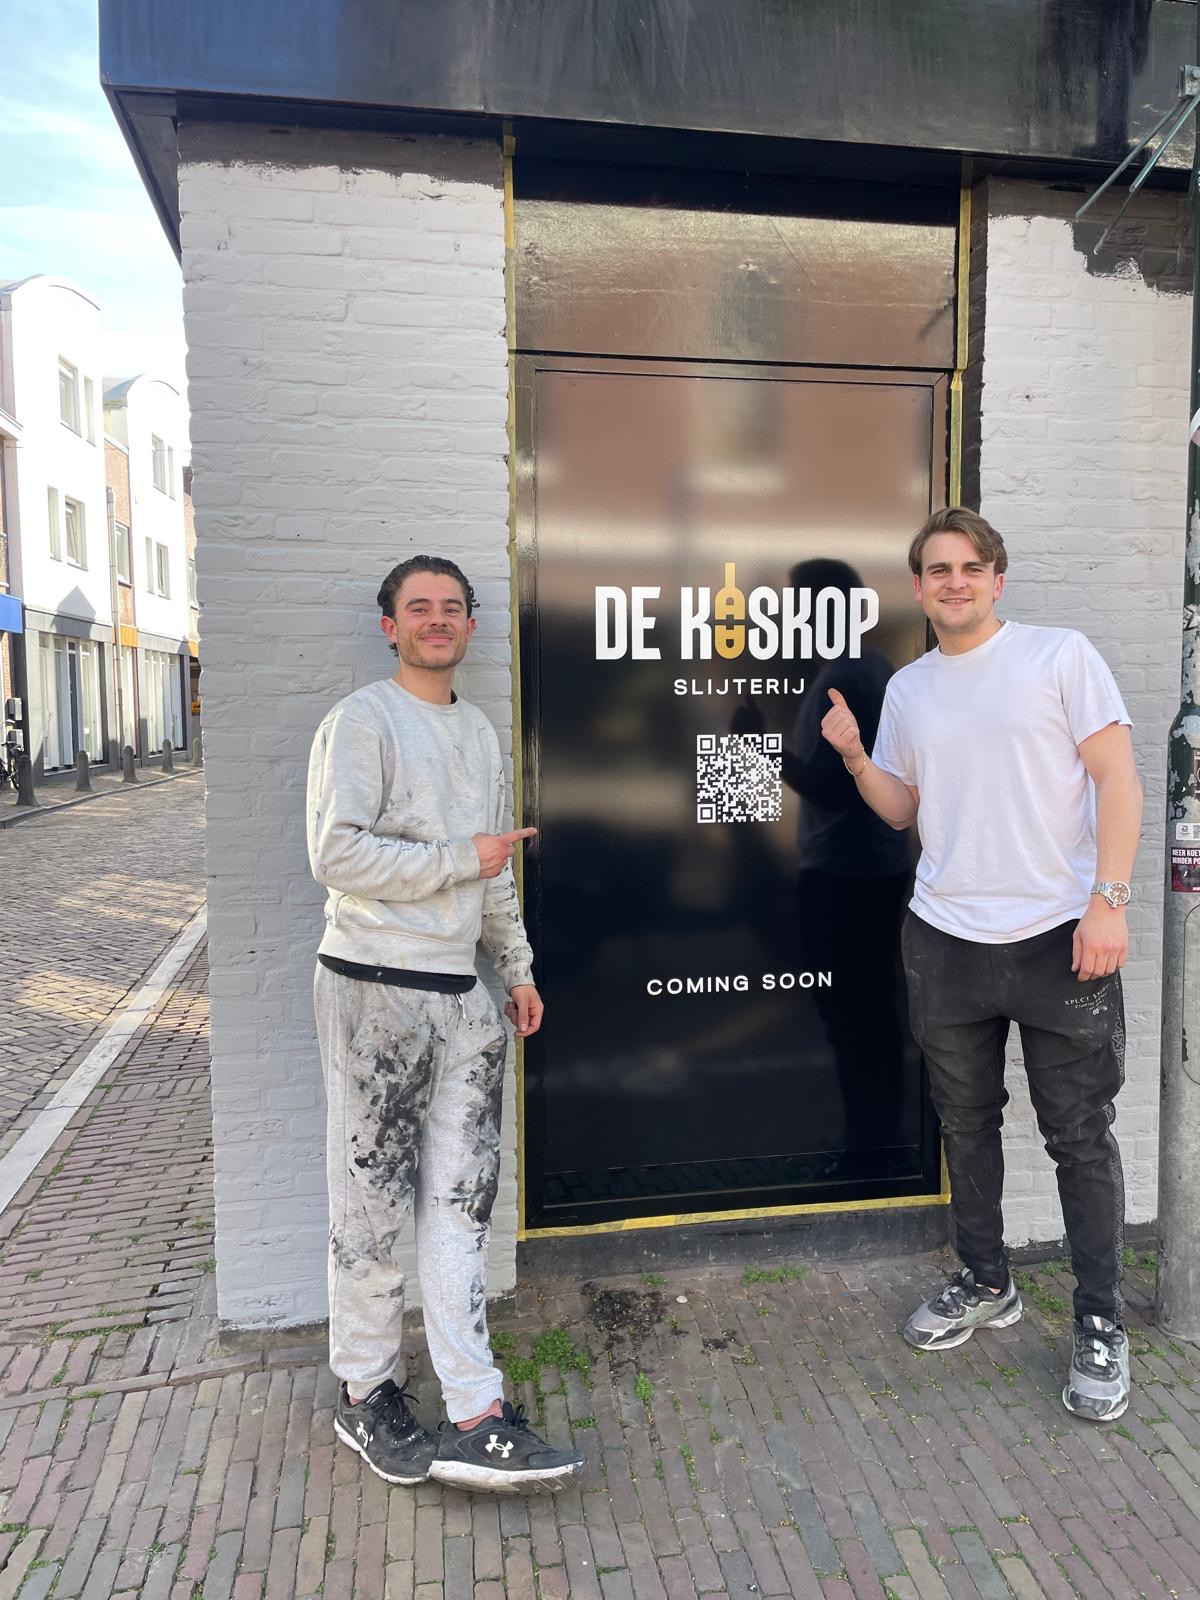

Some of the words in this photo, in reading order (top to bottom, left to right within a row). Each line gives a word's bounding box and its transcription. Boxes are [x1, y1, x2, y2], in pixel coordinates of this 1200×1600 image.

[595, 586, 662, 660] DE
[673, 678, 805, 695] SLIJTERIJ
[647, 975, 749, 995] COMING
[762, 972, 832, 990] SOON
